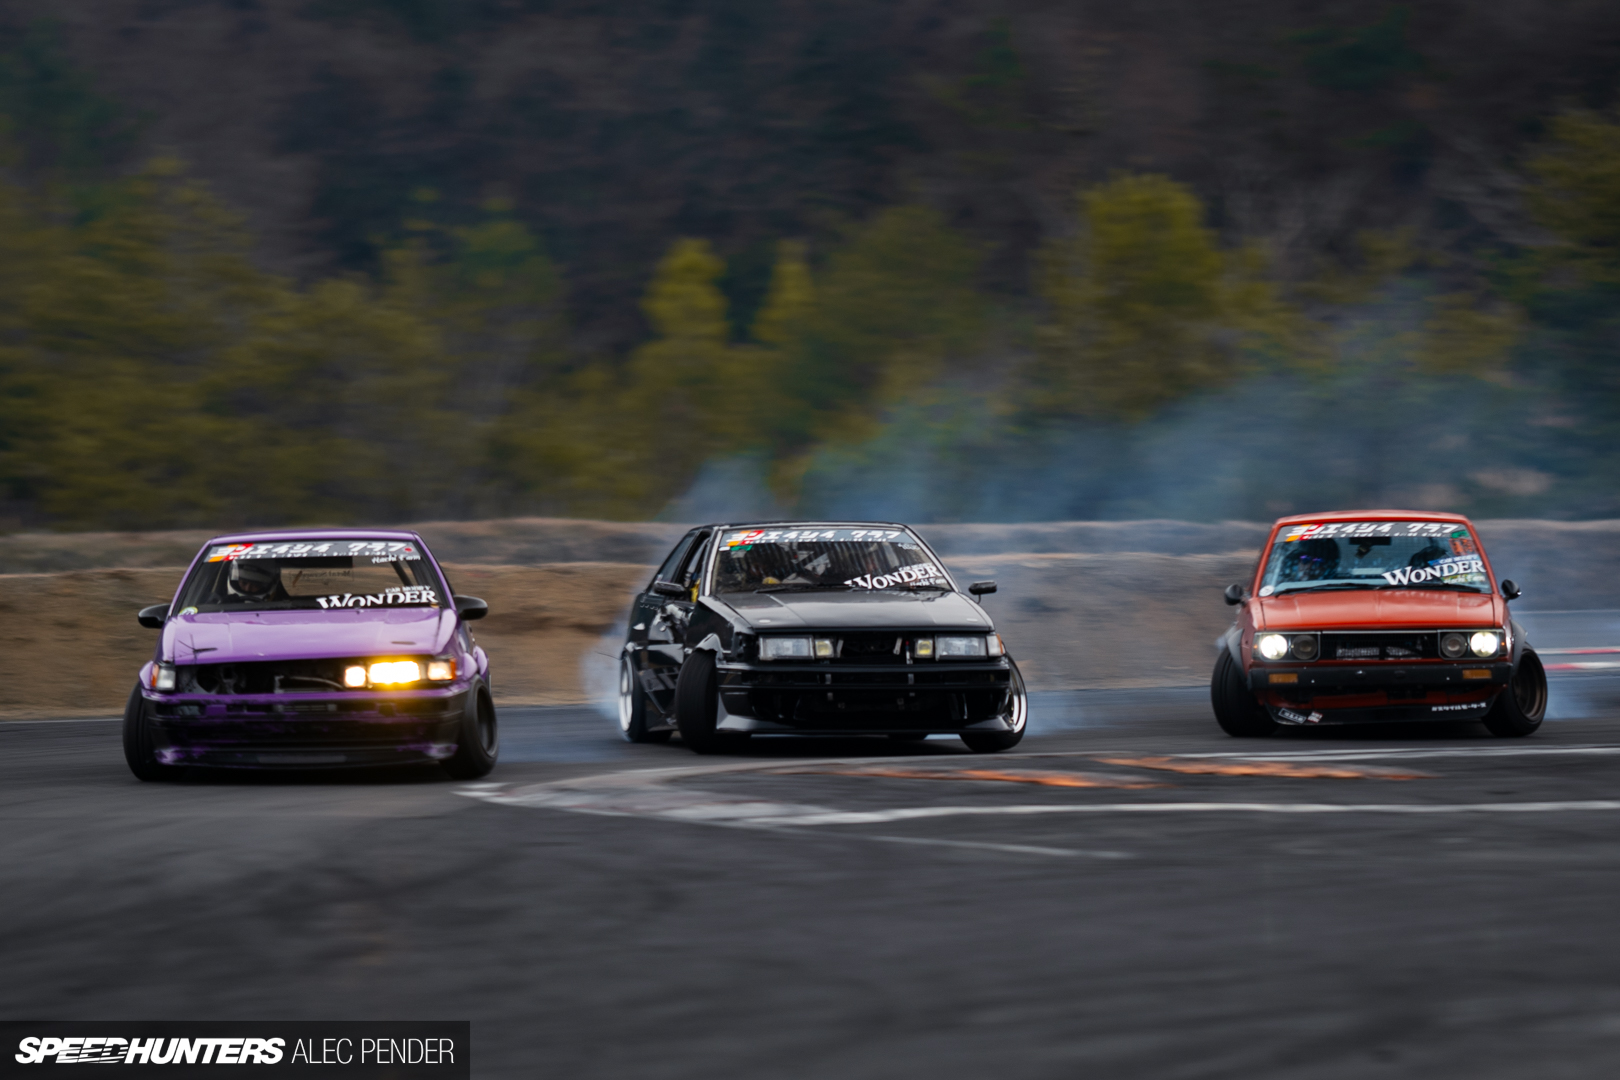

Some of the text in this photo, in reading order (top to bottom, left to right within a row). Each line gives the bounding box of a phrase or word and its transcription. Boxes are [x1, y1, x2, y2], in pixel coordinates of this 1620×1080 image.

[843, 566, 943, 590] WONDER
[1381, 560, 1487, 586] WONDER
[316, 590, 439, 609] WONDER
